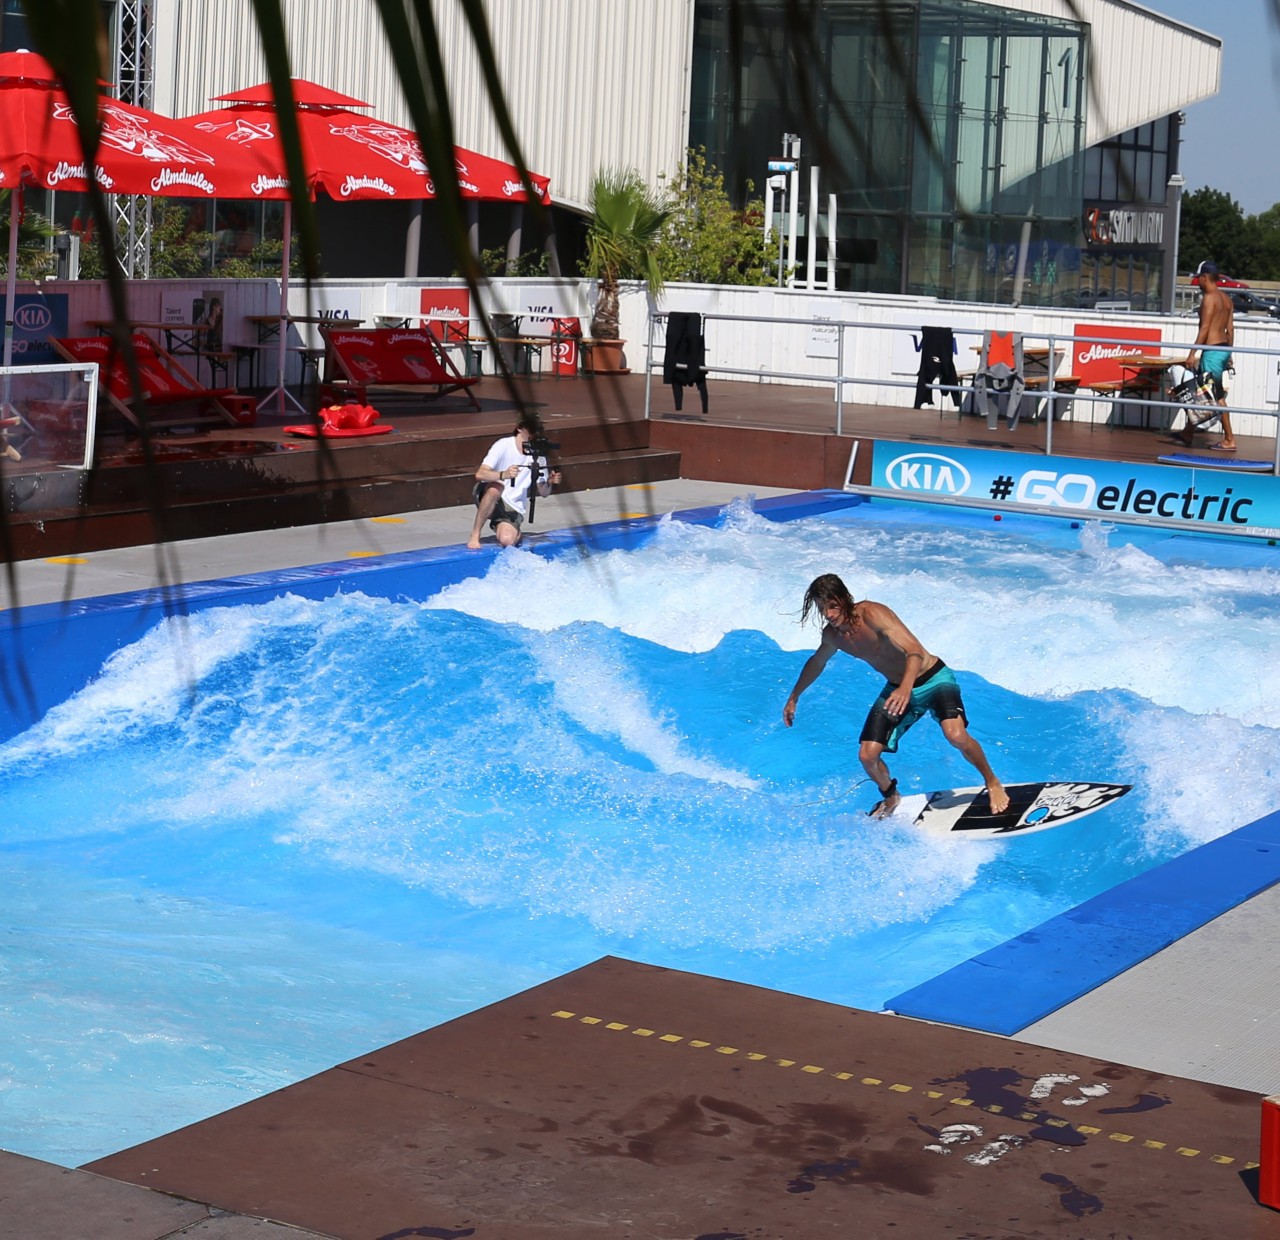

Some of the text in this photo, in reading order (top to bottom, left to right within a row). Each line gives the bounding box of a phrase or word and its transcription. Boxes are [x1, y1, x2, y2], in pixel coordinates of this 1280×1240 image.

[151, 168, 215, 194] Almdudler
[340, 175, 396, 196] Almdudler
[1112, 210, 1164, 244] SATURN
[20, 309, 46, 325] KIA
[334, 334, 375, 347] Almdudler
[387, 332, 428, 344] Almdudler
[900, 461, 956, 494] KIA
